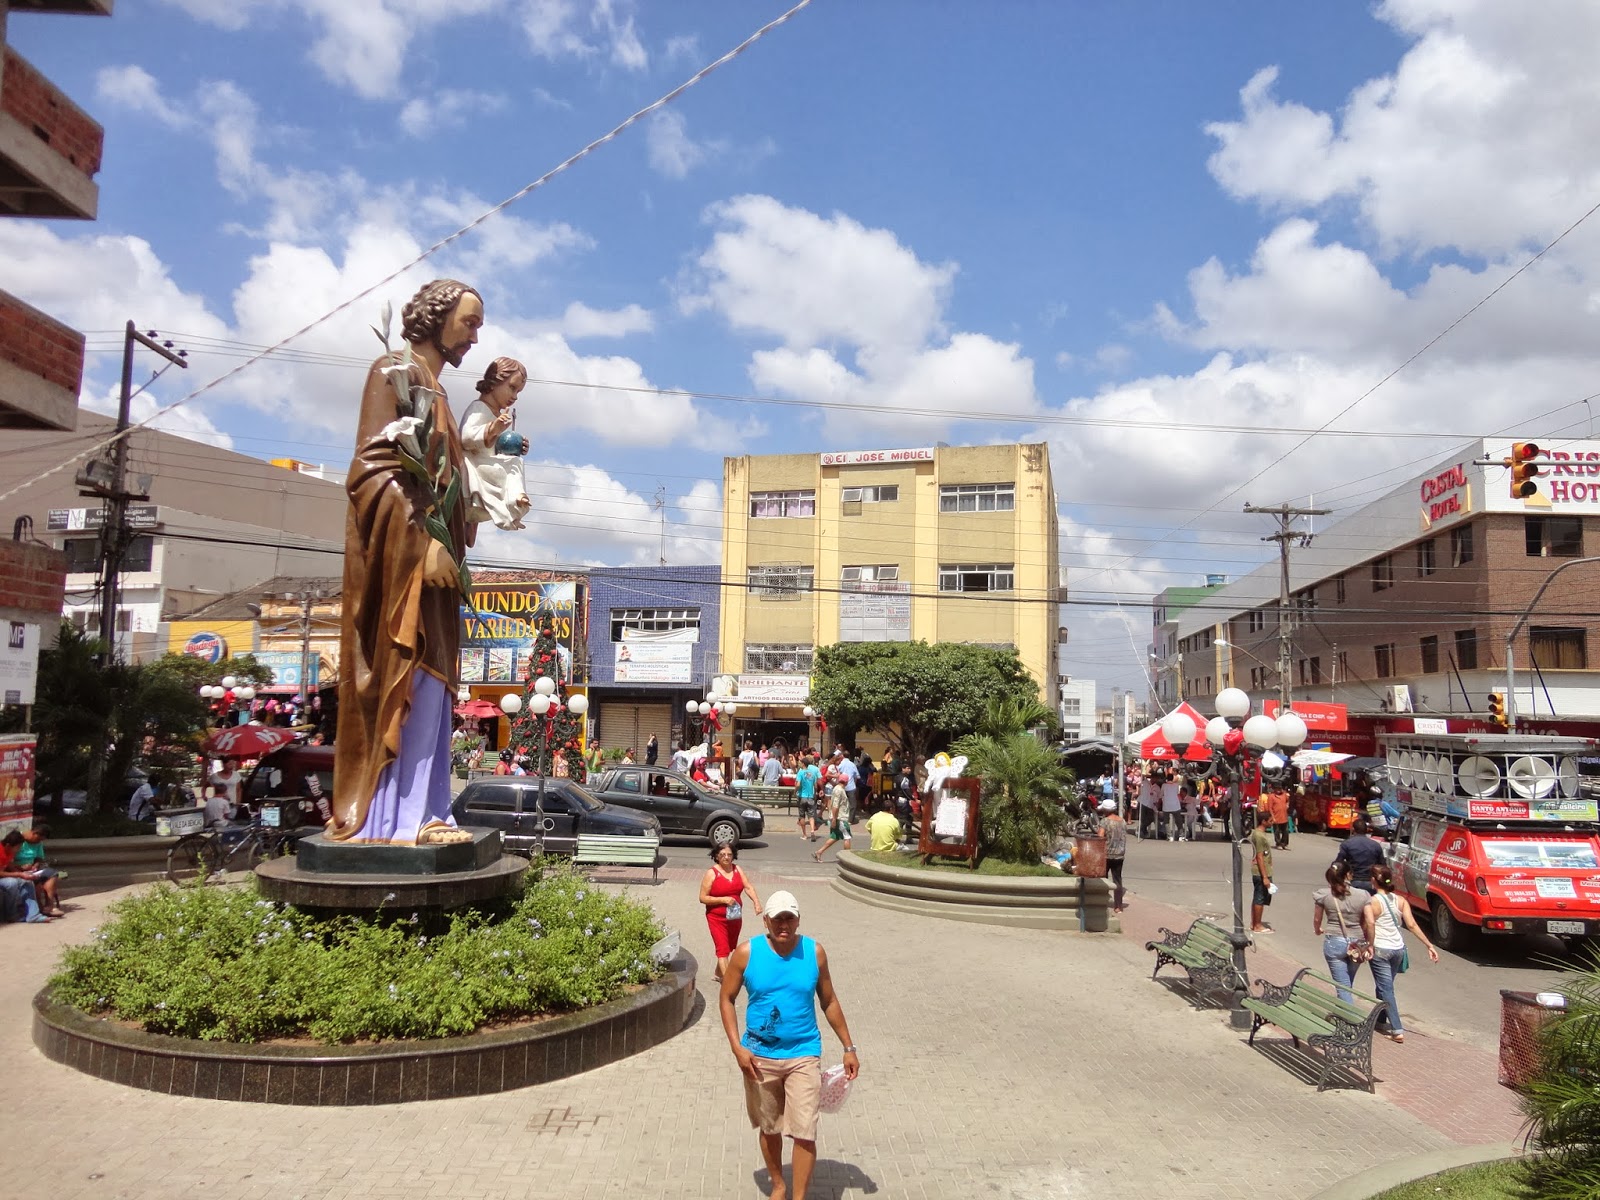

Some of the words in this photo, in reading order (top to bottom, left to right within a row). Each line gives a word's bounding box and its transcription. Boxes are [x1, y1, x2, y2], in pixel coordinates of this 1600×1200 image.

[856, 453, 885, 462] JOSE
[891, 450, 932, 460] MIGUEL
[1421, 463, 1467, 503] CRISTAL
[1430, 493, 1461, 521] HOTEL
[464, 591, 540, 614] MUNDO
[9, 625, 25, 644] MP
[464, 617, 571, 639] VARIEDAES
[1418, 722, 1443, 730] CRISTAL
